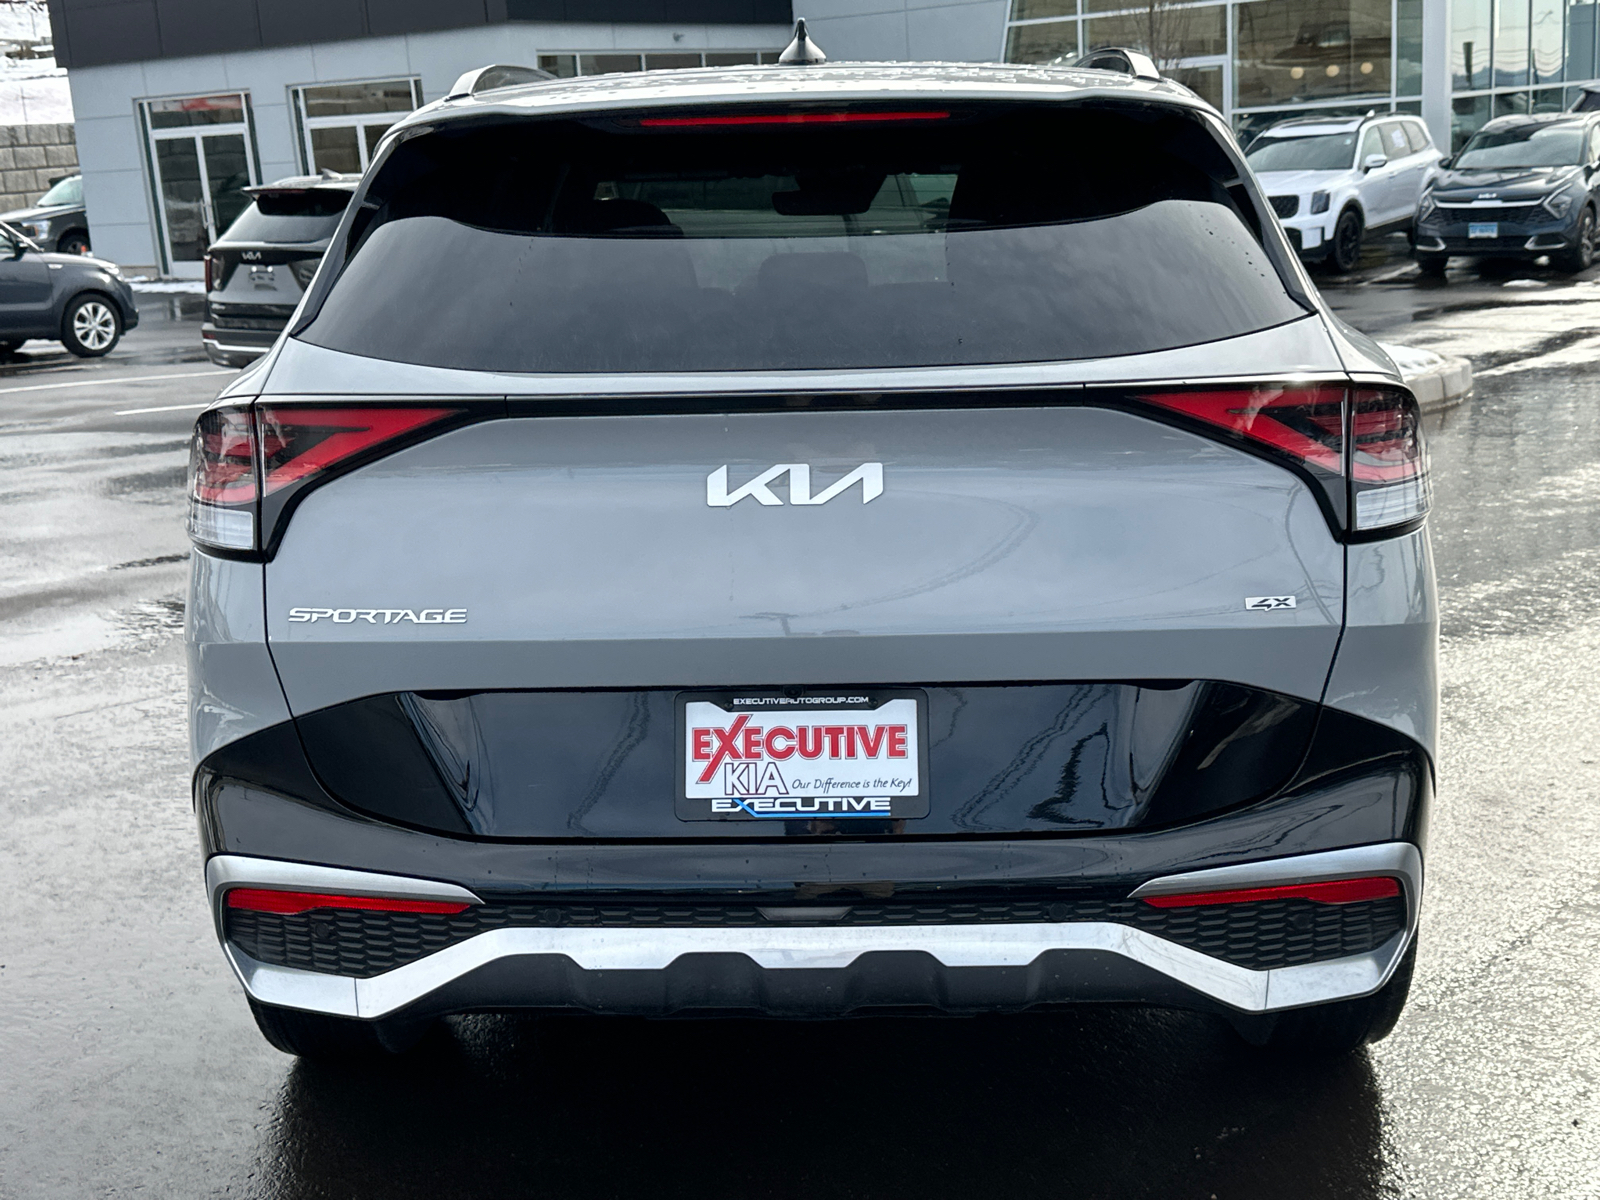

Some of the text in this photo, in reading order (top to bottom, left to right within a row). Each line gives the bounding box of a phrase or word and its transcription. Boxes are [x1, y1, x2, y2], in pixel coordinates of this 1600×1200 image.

[707, 462, 883, 507] KIA
[288, 607, 467, 624] SPORTAGE
[733, 697, 869, 706] EXECUTIVEAUTOGROUP.COM
[692, 714, 908, 784] EXECUTIVE
[724, 762, 789, 795] KIA
[792, 778, 912, 793] Our Difference is the Key!
[712, 798, 891, 816] EXECUTIVE
